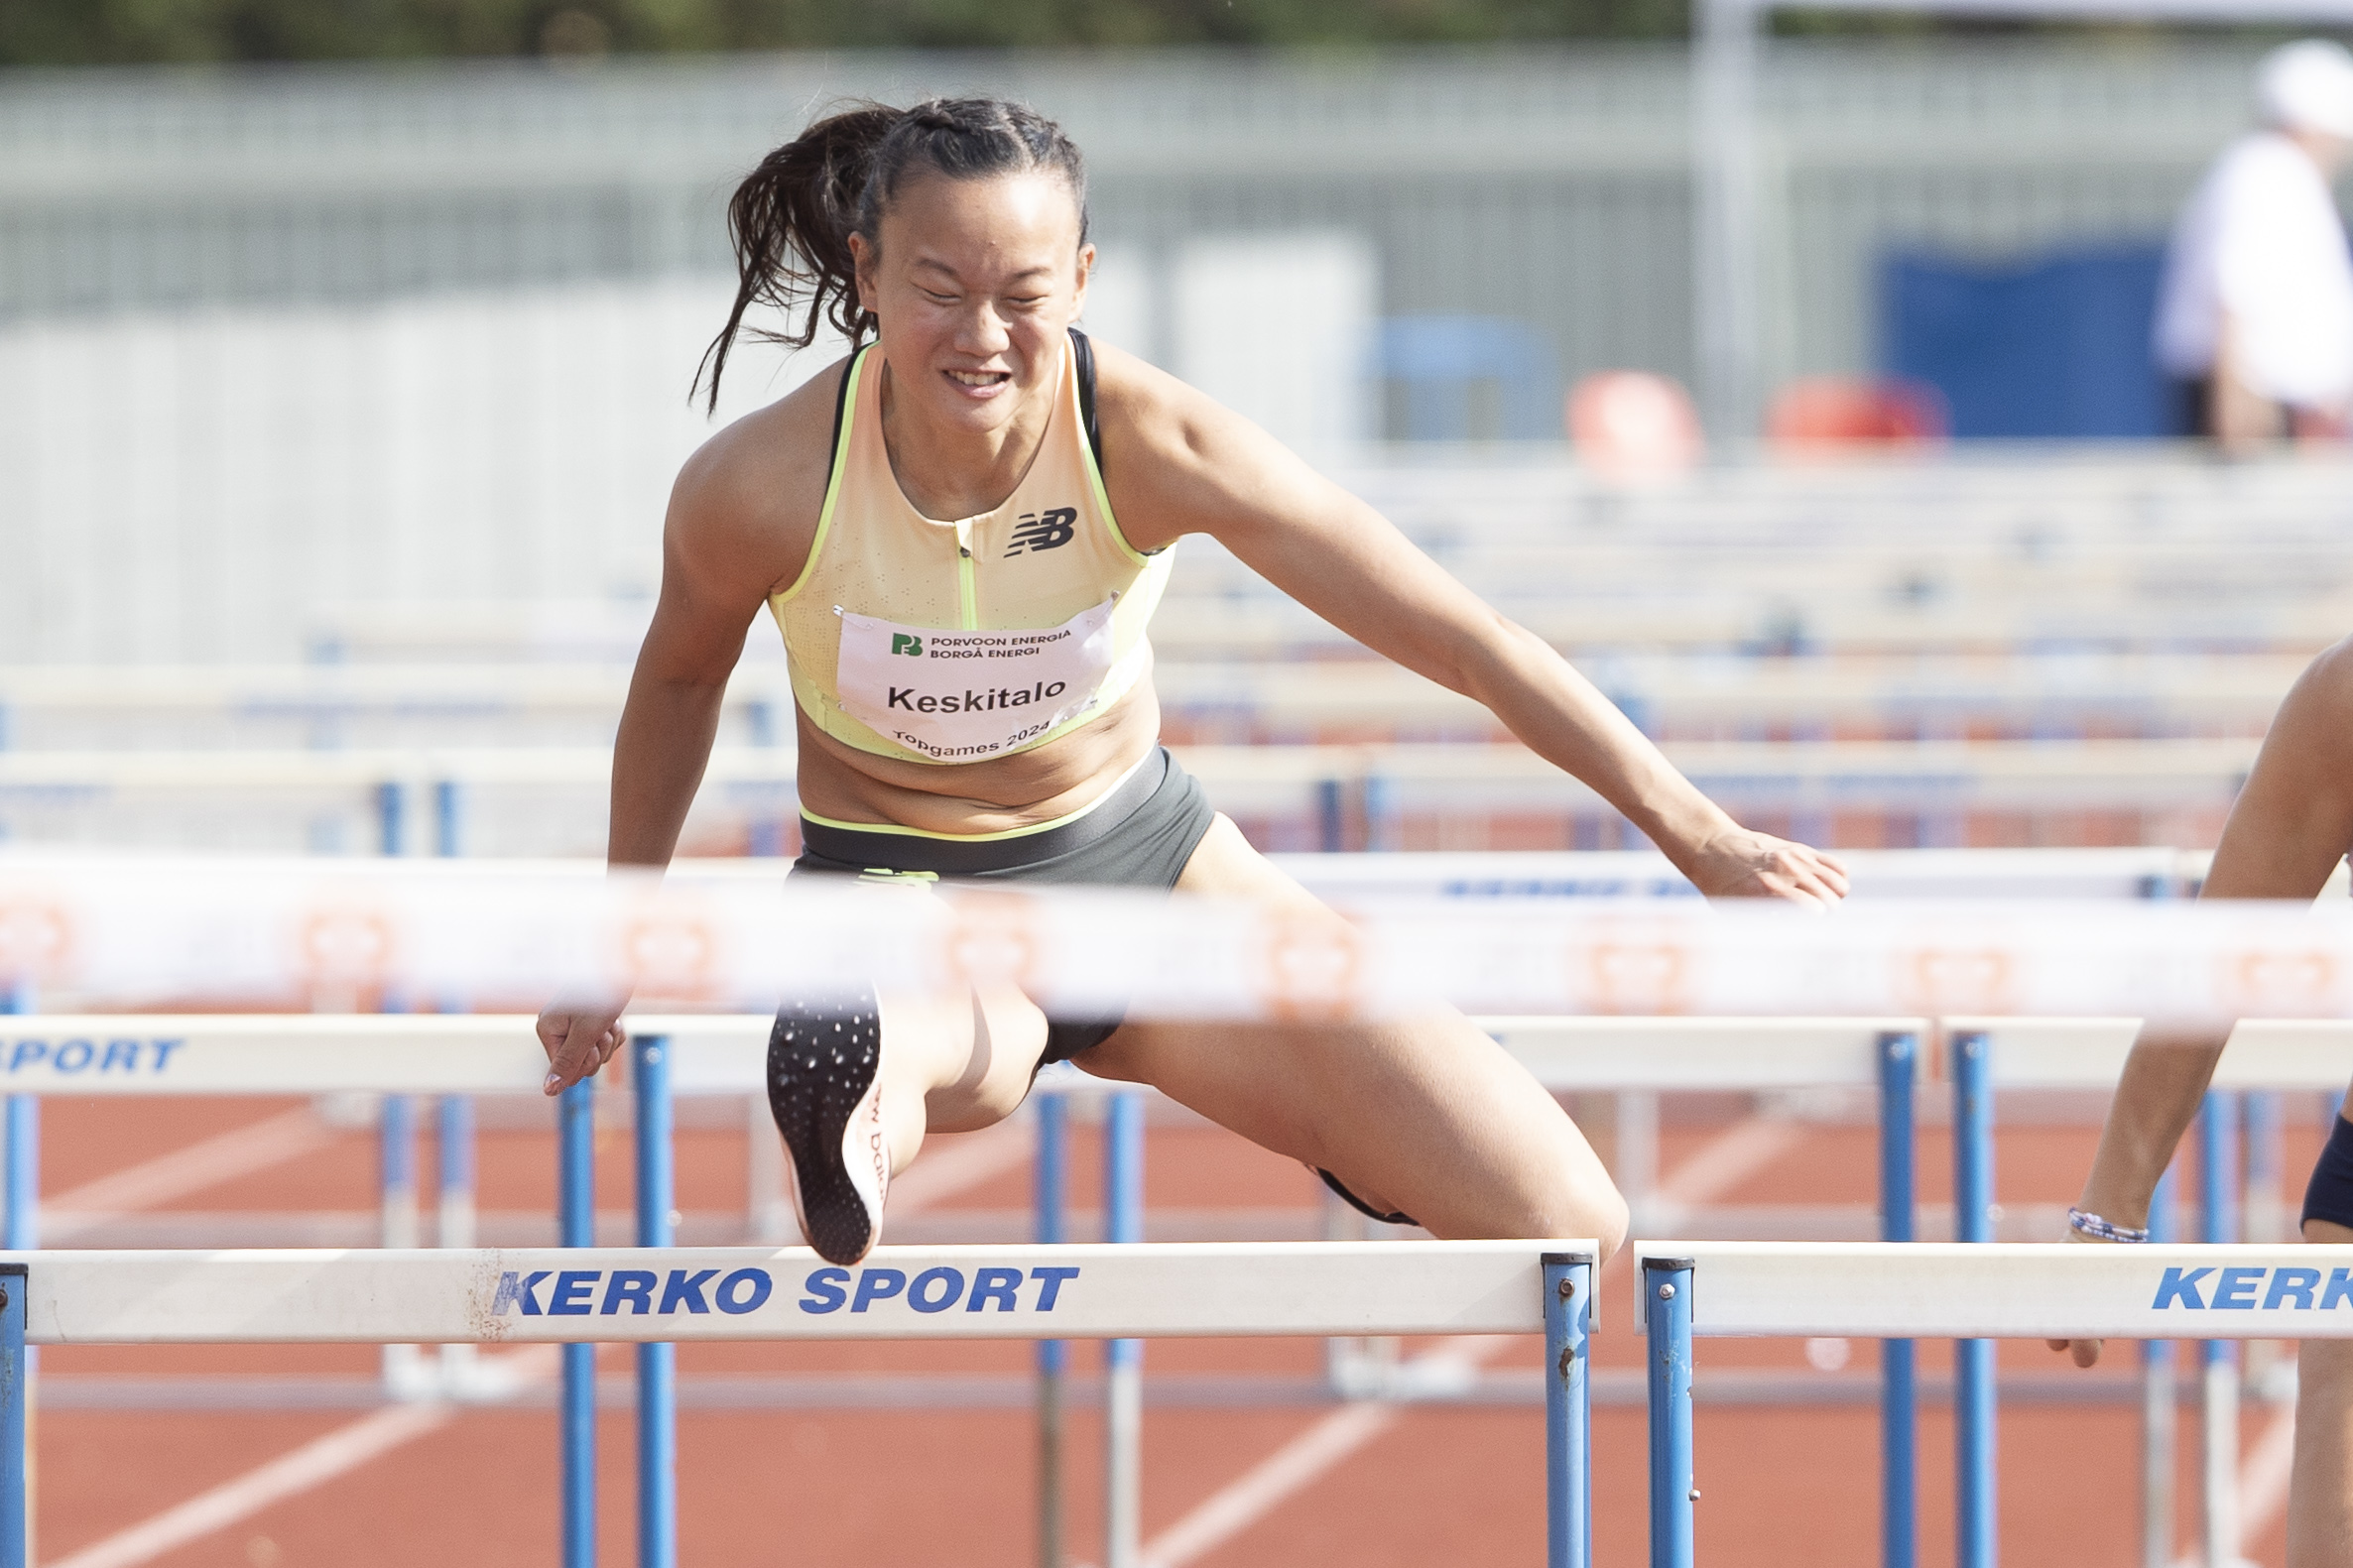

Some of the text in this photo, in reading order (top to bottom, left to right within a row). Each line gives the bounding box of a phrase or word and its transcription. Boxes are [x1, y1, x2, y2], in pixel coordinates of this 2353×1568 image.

[929, 647, 1040, 659] BORGÅ ENERGI
[930, 629, 1071, 647] PORVOON ENERGIA
[887, 680, 1066, 714] Keskitalo
[892, 719, 1051, 758] Topgames 2024
[0, 1037, 186, 1075] PORT
[494, 1266, 1080, 1316] KERKO SPORT
